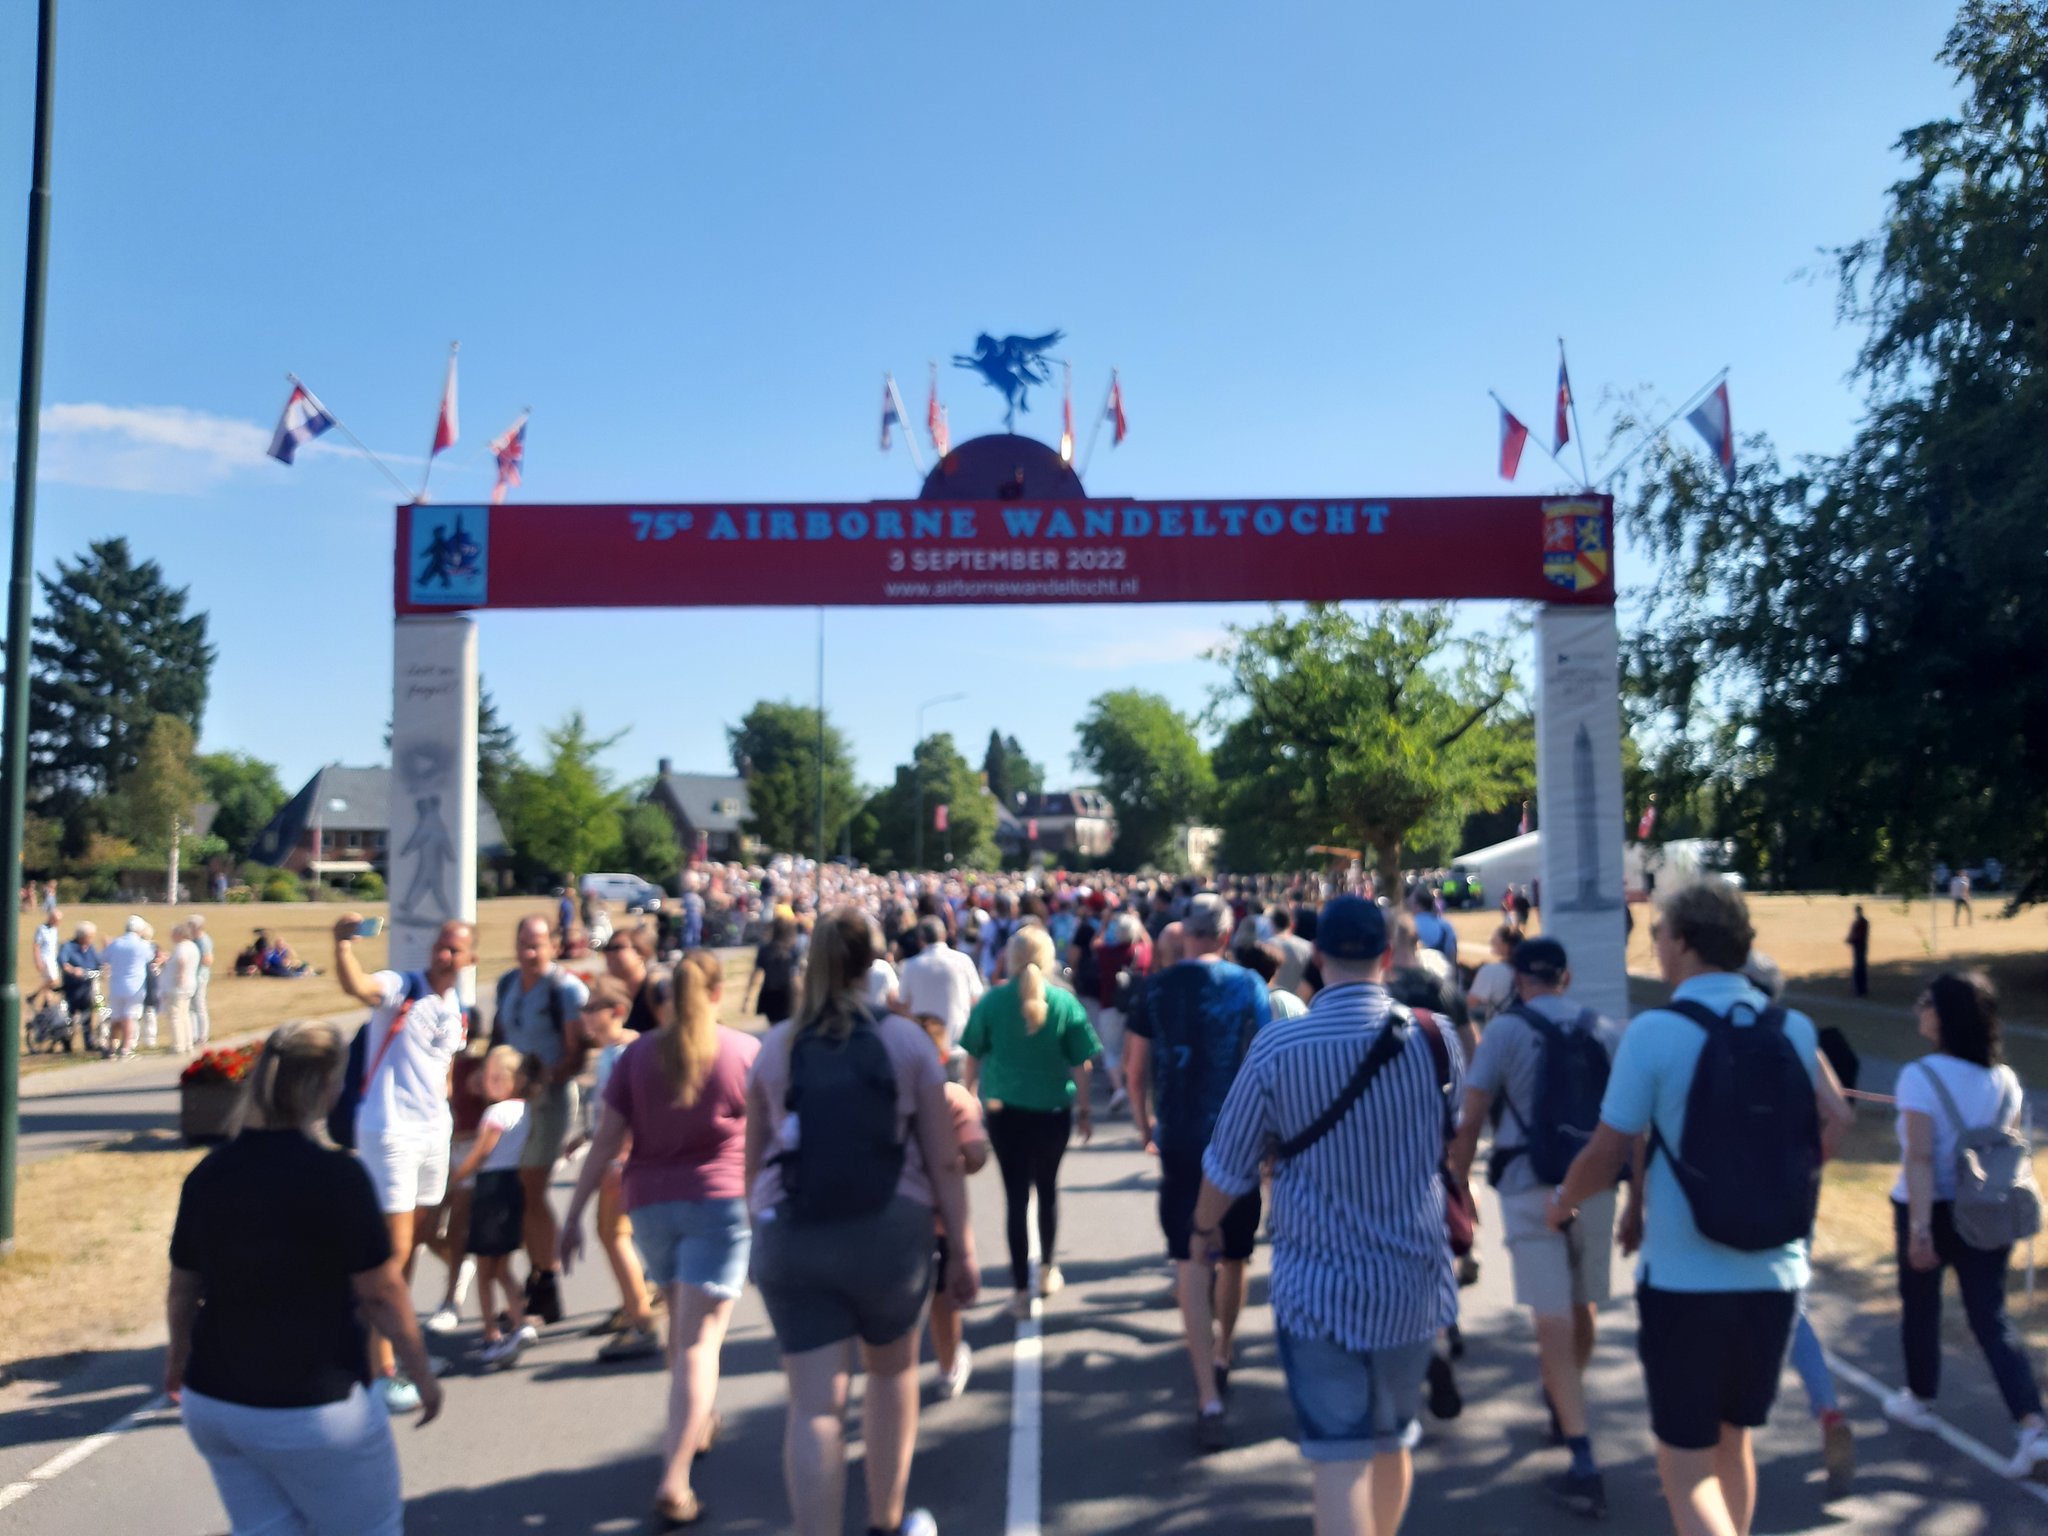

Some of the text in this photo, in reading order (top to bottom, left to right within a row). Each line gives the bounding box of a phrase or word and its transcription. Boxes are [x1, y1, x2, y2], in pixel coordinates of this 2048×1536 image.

[708, 509, 976, 541] AIRBORNE
[1003, 505, 1390, 538] WANDELTOCHT
[888, 548, 1126, 571] 3 SEPTEMBER 2022
[884, 577, 1139, 598] www.airbornewandeltocht.nl
